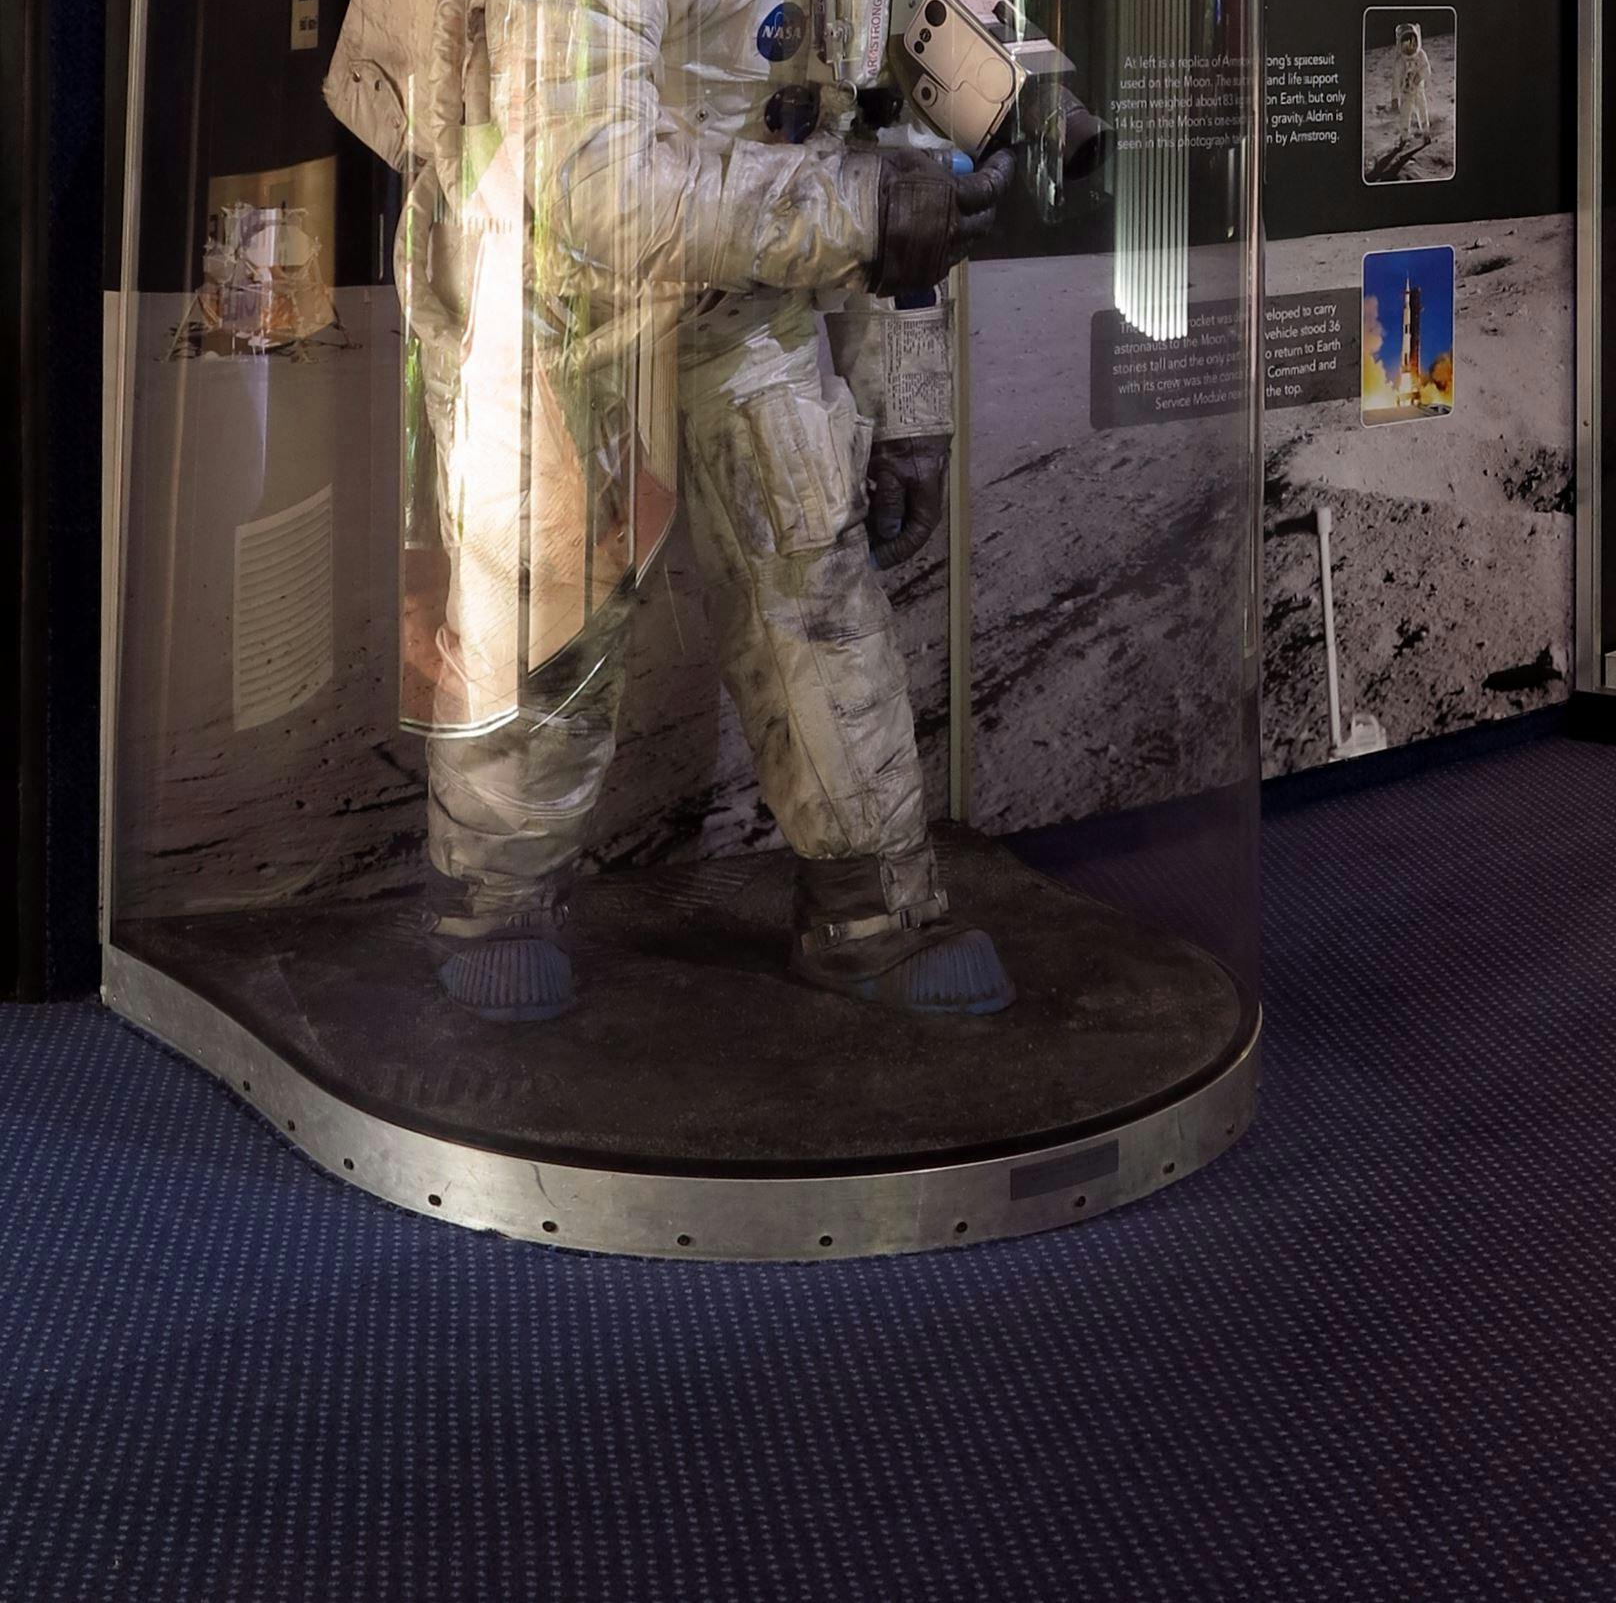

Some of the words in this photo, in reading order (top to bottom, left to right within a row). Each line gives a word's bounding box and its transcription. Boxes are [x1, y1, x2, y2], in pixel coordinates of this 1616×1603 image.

[762, 26, 802, 39] NASA
[1140, 56, 1156, 68] left
[1159, 57, 1167, 68] is
[1169, 58, 1175, 68] a
[1178, 56, 1209, 71] replica
[1212, 54, 1221, 68] of
[1294, 54, 1335, 68] spacesuit
[1121, 77, 1145, 89] used
[1148, 79, 1161, 88] on
[1164, 76, 1180, 88] the
[1266, 74, 1285, 85] and
[1288, 75, 1303, 85] life
[1304, 73, 1338, 90] support
[1111, 100, 1147, 112] system
[1150, 95, 1192, 111] weighed
[1195, 96, 1221, 107] about
[1308, 92, 1324, 104] but
[1326, 90, 1346, 106] only
[1115, 117, 1126, 129] 14
[1130, 116, 1143, 132] kg
[1158, 115, 1174, 128] the
[1306, 110, 1333, 122] Aldrin
[1336, 110, 1343, 121] is
[1117, 139, 1142, 150] seen
[1157, 135, 1175, 147] this
[1178, 133, 1229, 150] photograph
[1275, 131, 1287, 146] by
[1290, 130, 1339, 143] Armstrong.
[1303, 306, 1312, 316] to
[1314, 304, 1337, 317] carry
[1114, 340, 1167, 355] astronauts
[1170, 340, 1180, 349] to
[1183, 337, 1198, 347] the
[1264, 324, 1298, 341] vehicle
[1300, 322, 1326, 336] stood
[1329, 321, 1341, 333] 36
[1150, 358, 1166, 371] tall
[1169, 357, 1187, 369] and
[1189, 355, 1204, 366] the
[1275, 345, 1303, 358] return
[1304, 344, 1314, 354] to
[1317, 339, 1341, 353] Earth
[1119, 381, 1140, 394] with
[1143, 380, 1155, 391] its
[1267, 362, 1316, 378] Command
[1318, 358, 1336, 370] and
[1155, 396, 1190, 410] Service
[1193, 392, 1227, 405] Module
[1266, 385, 1281, 397] the
